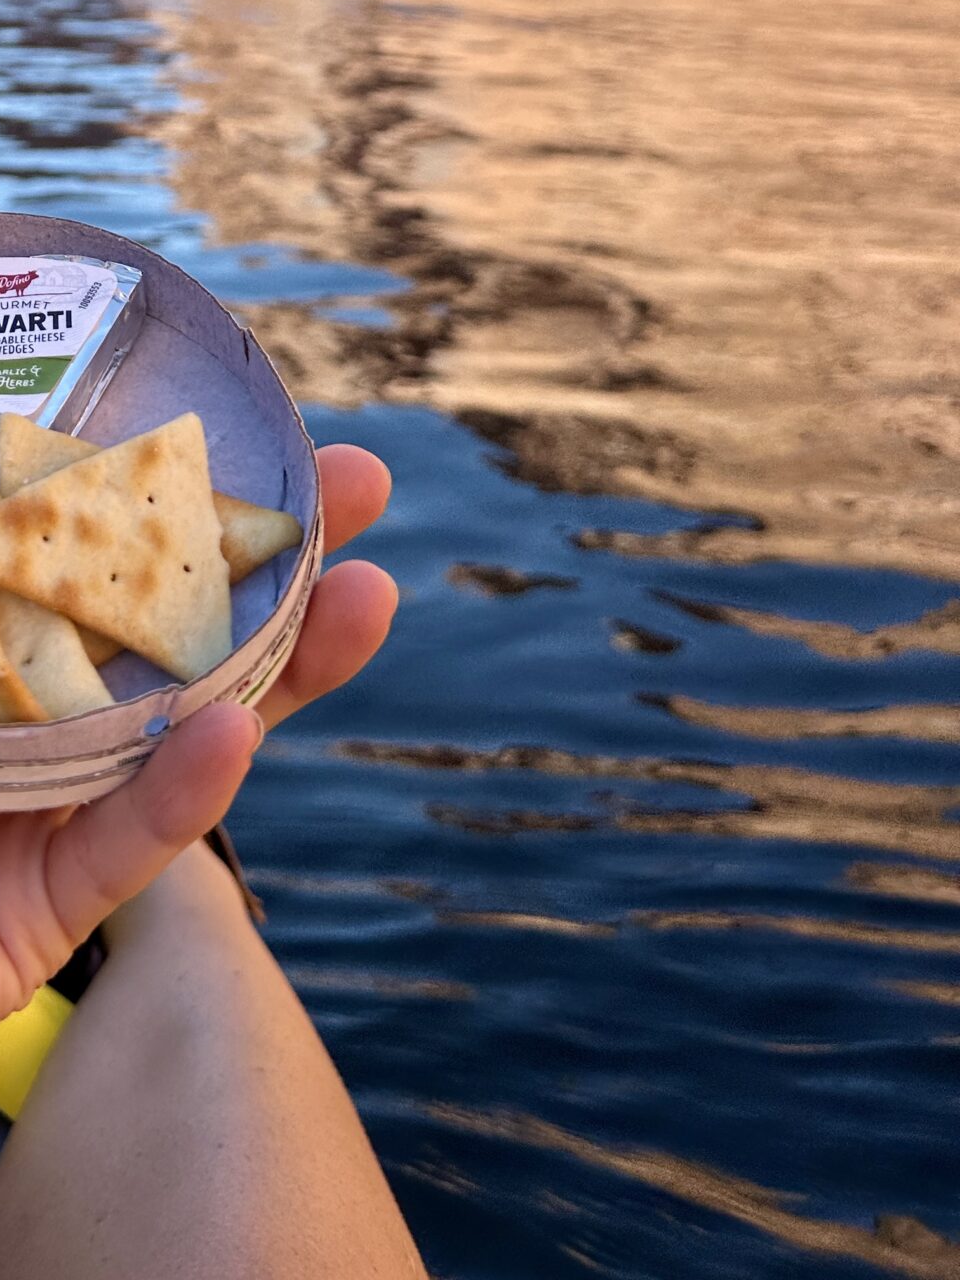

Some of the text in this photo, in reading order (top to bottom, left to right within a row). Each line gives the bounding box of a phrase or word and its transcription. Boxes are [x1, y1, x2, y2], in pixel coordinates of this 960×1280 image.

[78, 281, 103, 310] 10093553
[27, 332, 66, 344] CHEESE
[30, 365, 42, 377] &
